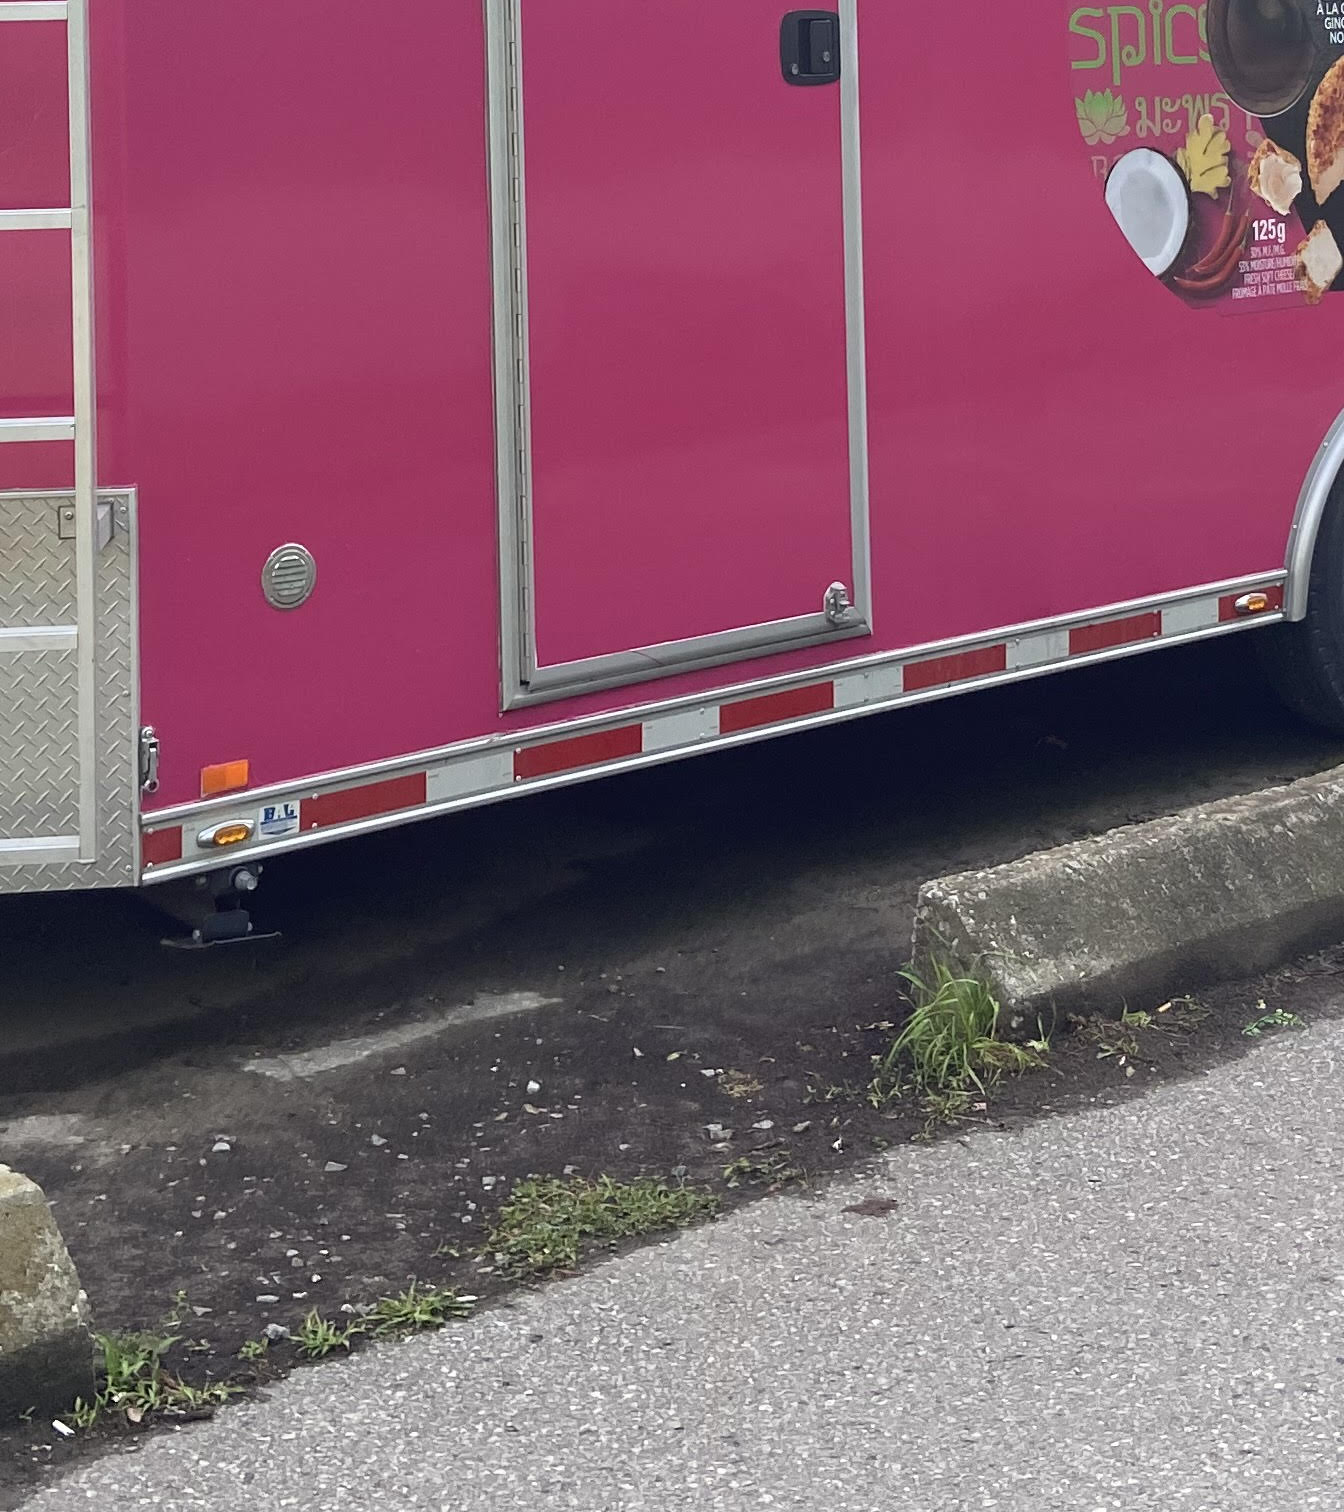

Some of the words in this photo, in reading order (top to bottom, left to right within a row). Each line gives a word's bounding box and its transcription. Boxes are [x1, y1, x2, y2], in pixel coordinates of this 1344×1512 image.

[1316, 0, 1325, 16] À
[1325, 2, 1339, 15] LA
[1252, 218, 1286, 244] 125g
